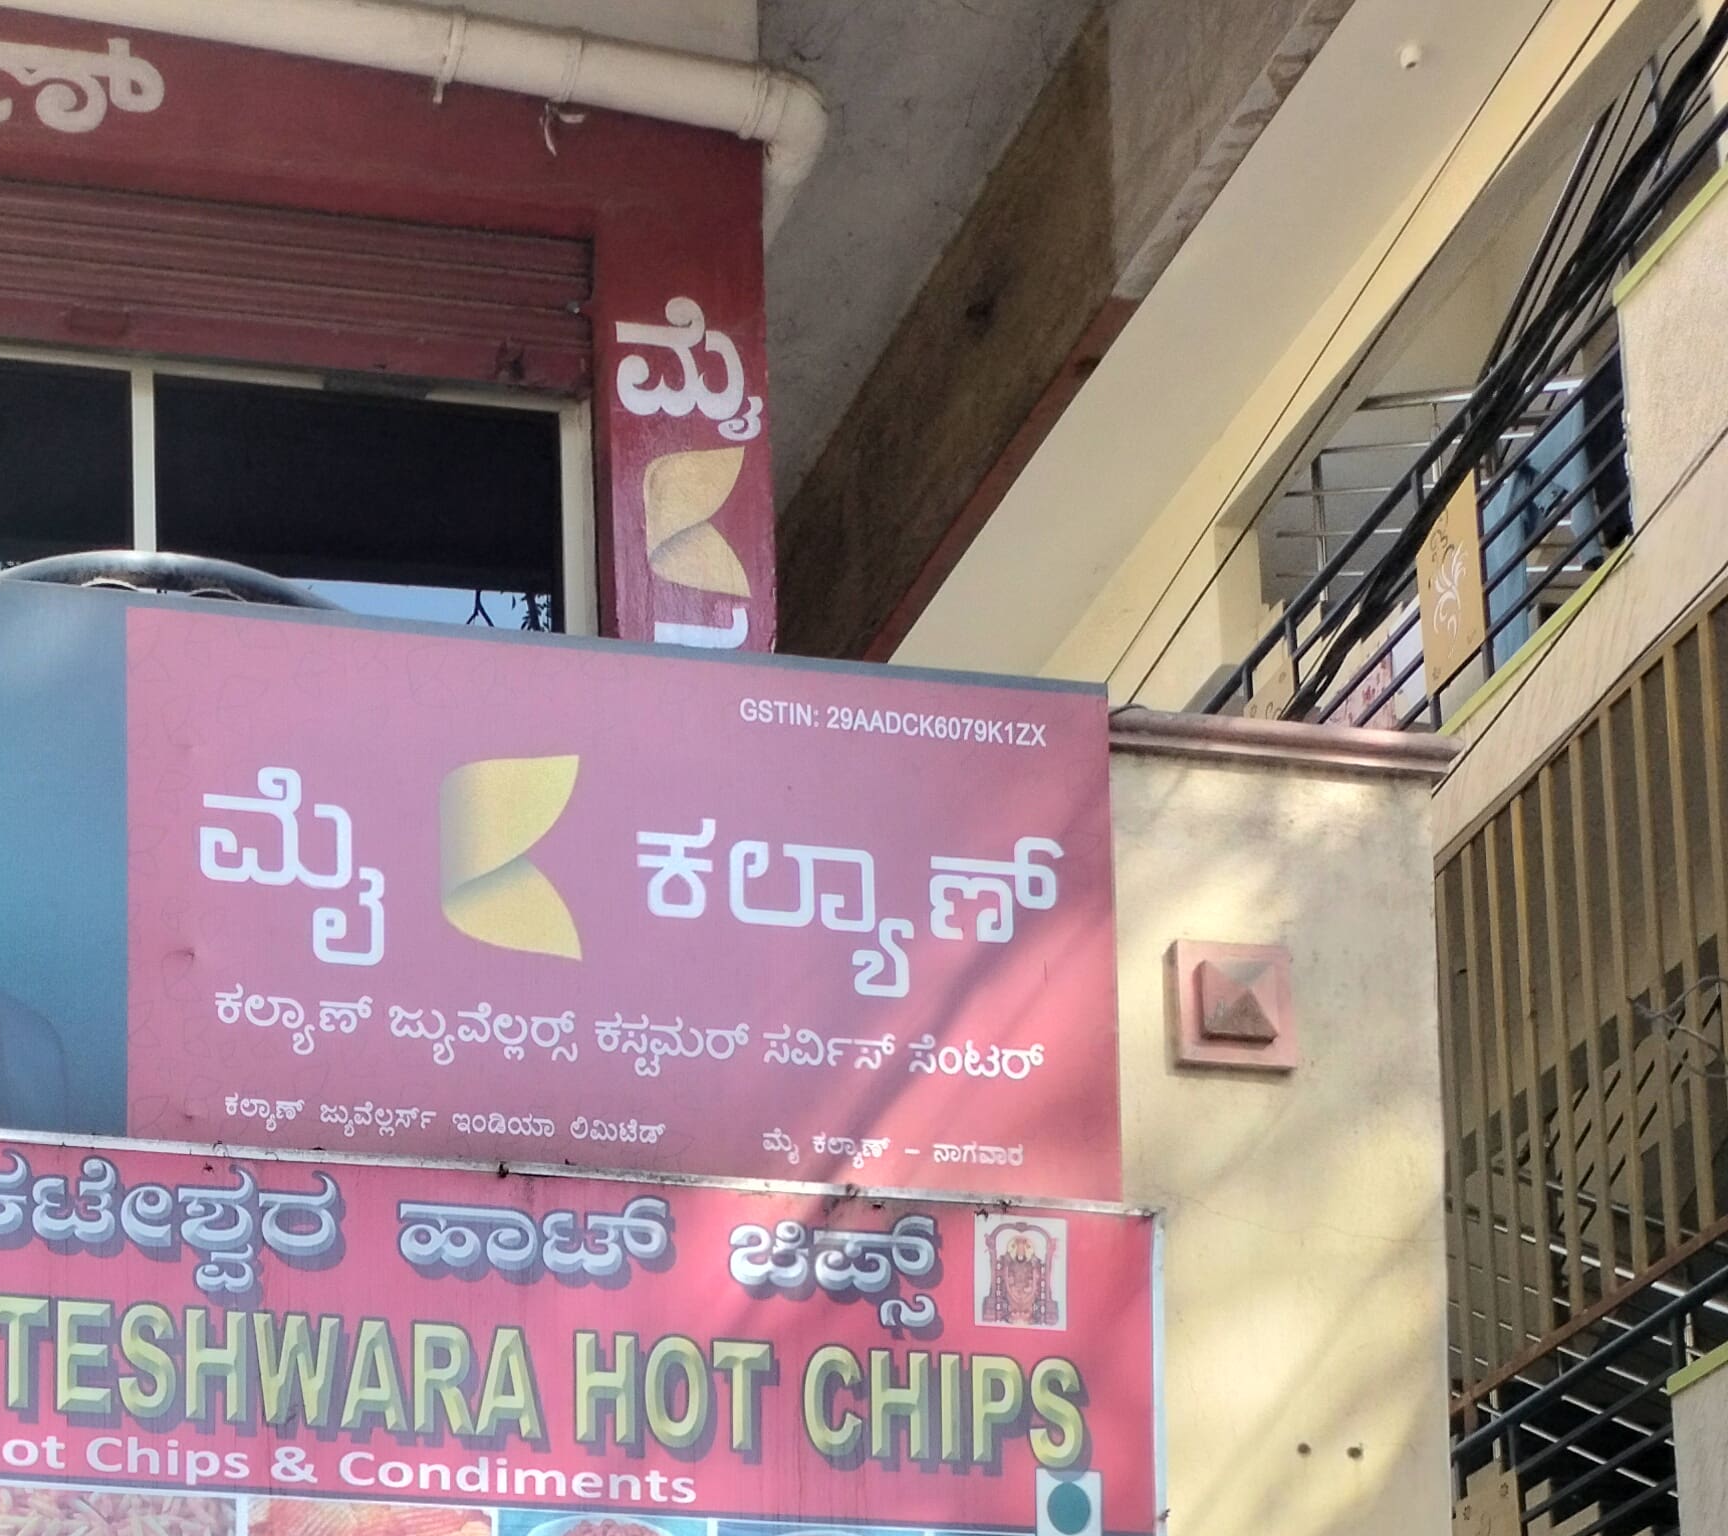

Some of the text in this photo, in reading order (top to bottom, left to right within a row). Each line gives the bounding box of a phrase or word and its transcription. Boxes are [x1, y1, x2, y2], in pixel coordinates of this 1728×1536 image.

[614, 296, 763, 441] ಮೈ
[739, 697, 1047, 748] GSTIN: 29AADCK6079K1ZX
[199, 766, 1065, 999] ಮೈ ಕಲ್ಯಾಣ್
[214, 983, 373, 1055] ಕಲ್ಯಾಣ್
[594, 1012, 750, 1077] ಕಸ್ಟಮರ್
[762, 1023, 895, 1071] ಸರ್ವಿಸ್
[907, 1033, 1045, 1080] ಸೆಂಟರ್
[224, 1092, 305, 1132] ಕಲ್ಯಾಣ್
[451, 1109, 556, 1138] ಇಂಡಿಯಾ
[569, 1115, 666, 1145] ಲಿಮಿಟೆಡ್
[762, 1127, 800, 1165] ಮೈ
[811, 1131, 891, 1168] ಕಲ್ಯಾಣ್
[932, 1140, 1024, 1167] ನಾಗವಾರ
[398, 1196, 672, 1278] ಹಾಟ್
[727, 1213, 940, 1330] ಚಿಪ್ಸ್
[572, 1328, 773, 1453] HOT
[802, 1342, 1086, 1470] CHIPS
[86, 1436, 251, 1485] Chips
[270, 1446, 318, 1484] &
[339, 1451, 698, 1504] Condiments
